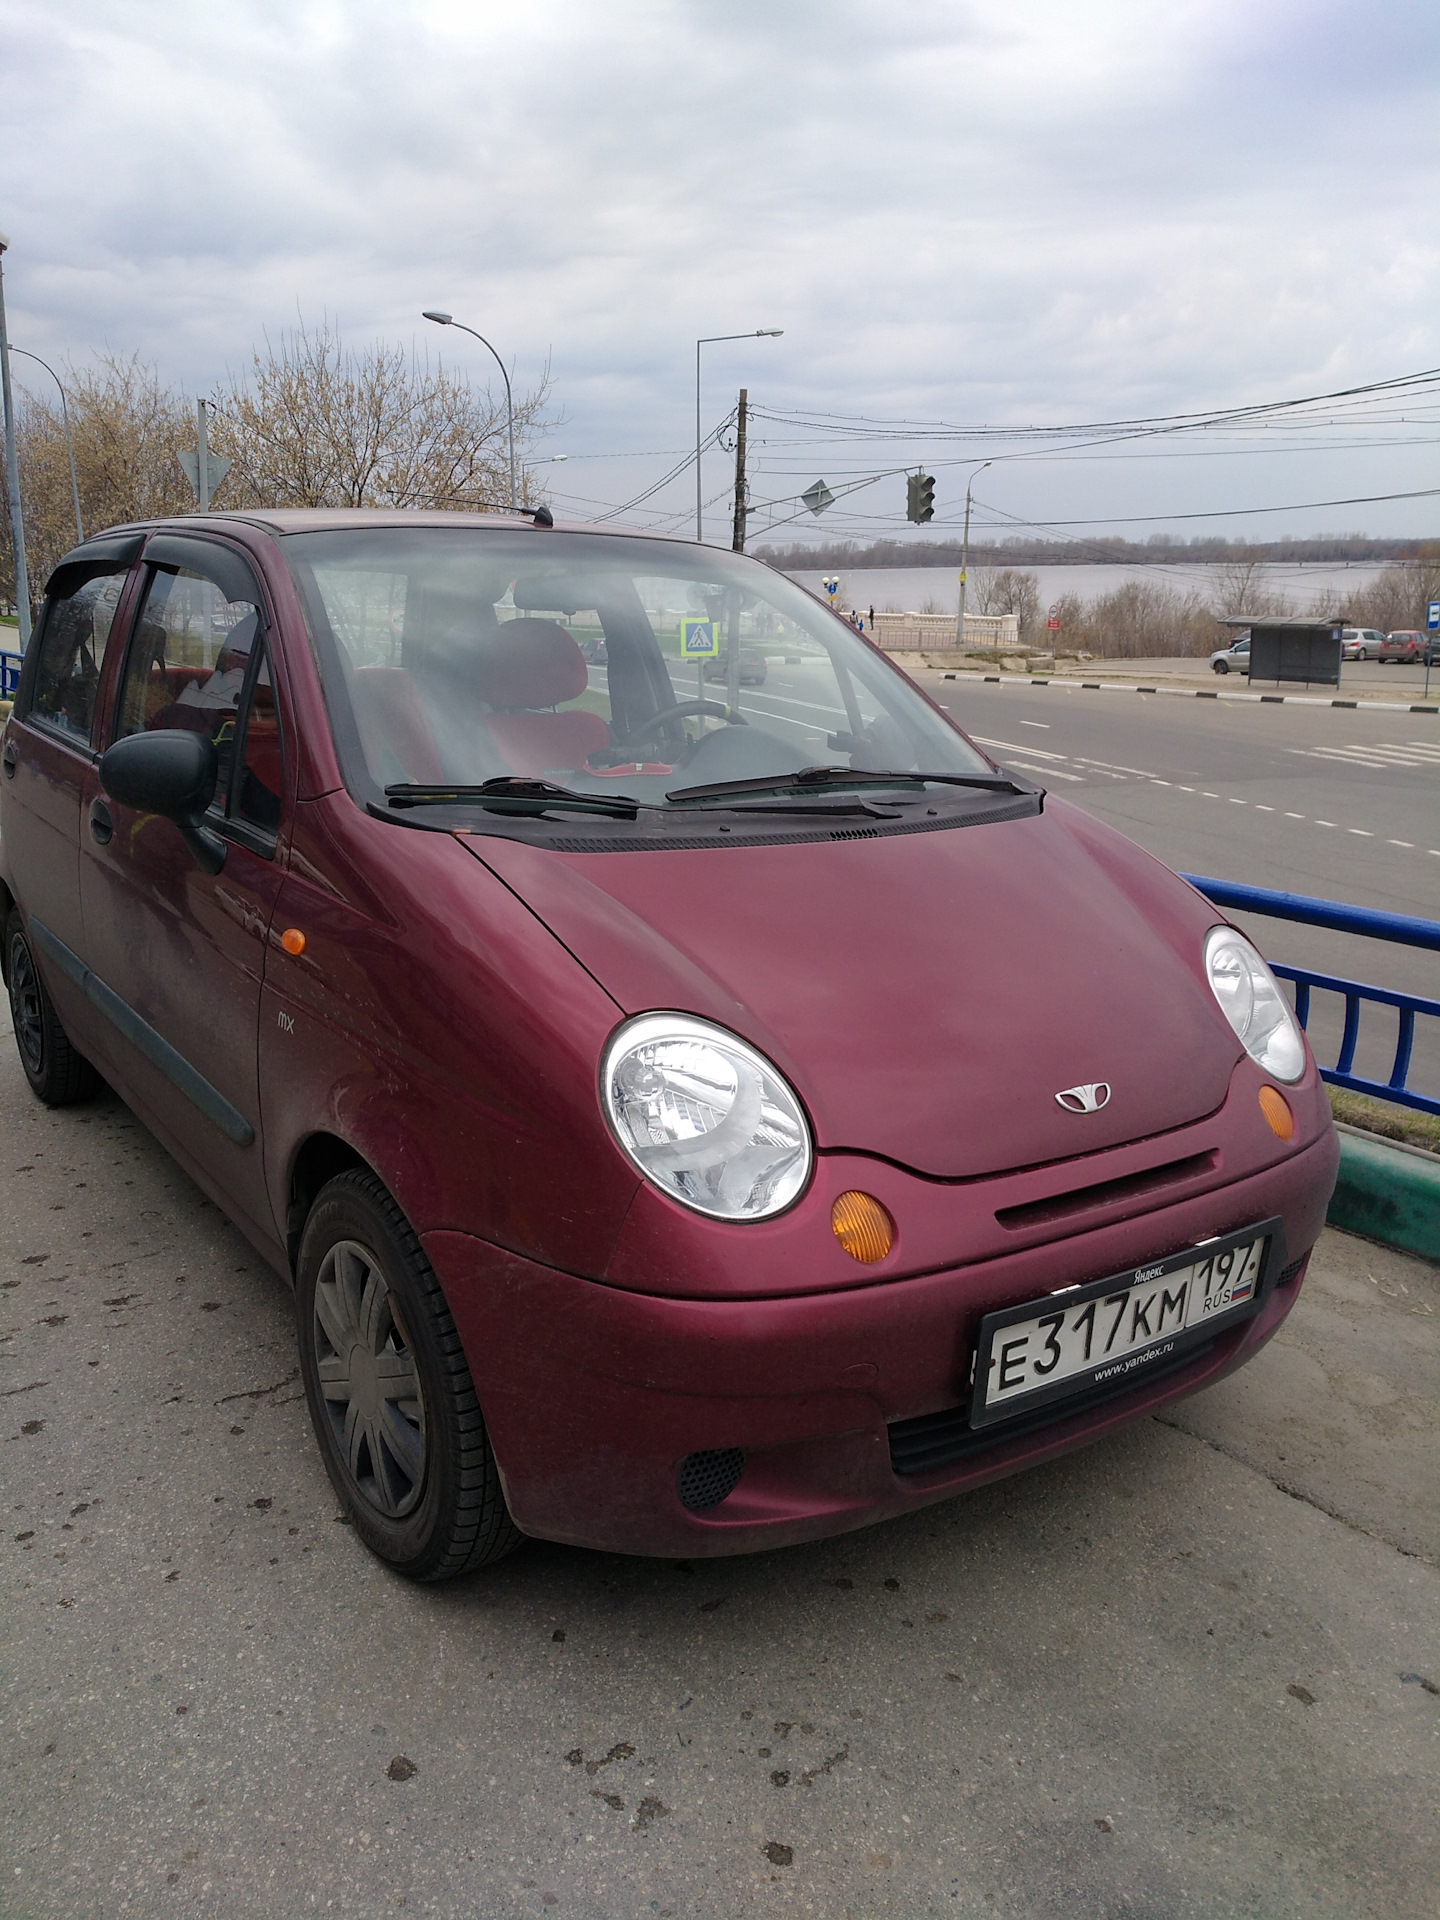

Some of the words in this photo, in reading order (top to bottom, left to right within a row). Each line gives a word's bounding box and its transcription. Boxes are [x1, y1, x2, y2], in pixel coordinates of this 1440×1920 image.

[1133, 1265, 1164, 1285] Яндекс
[1197, 1240, 1256, 1298] 197
[1203, 1289, 1231, 1314] RUS
[1094, 1341, 1174, 1382] www.yandex.ru
